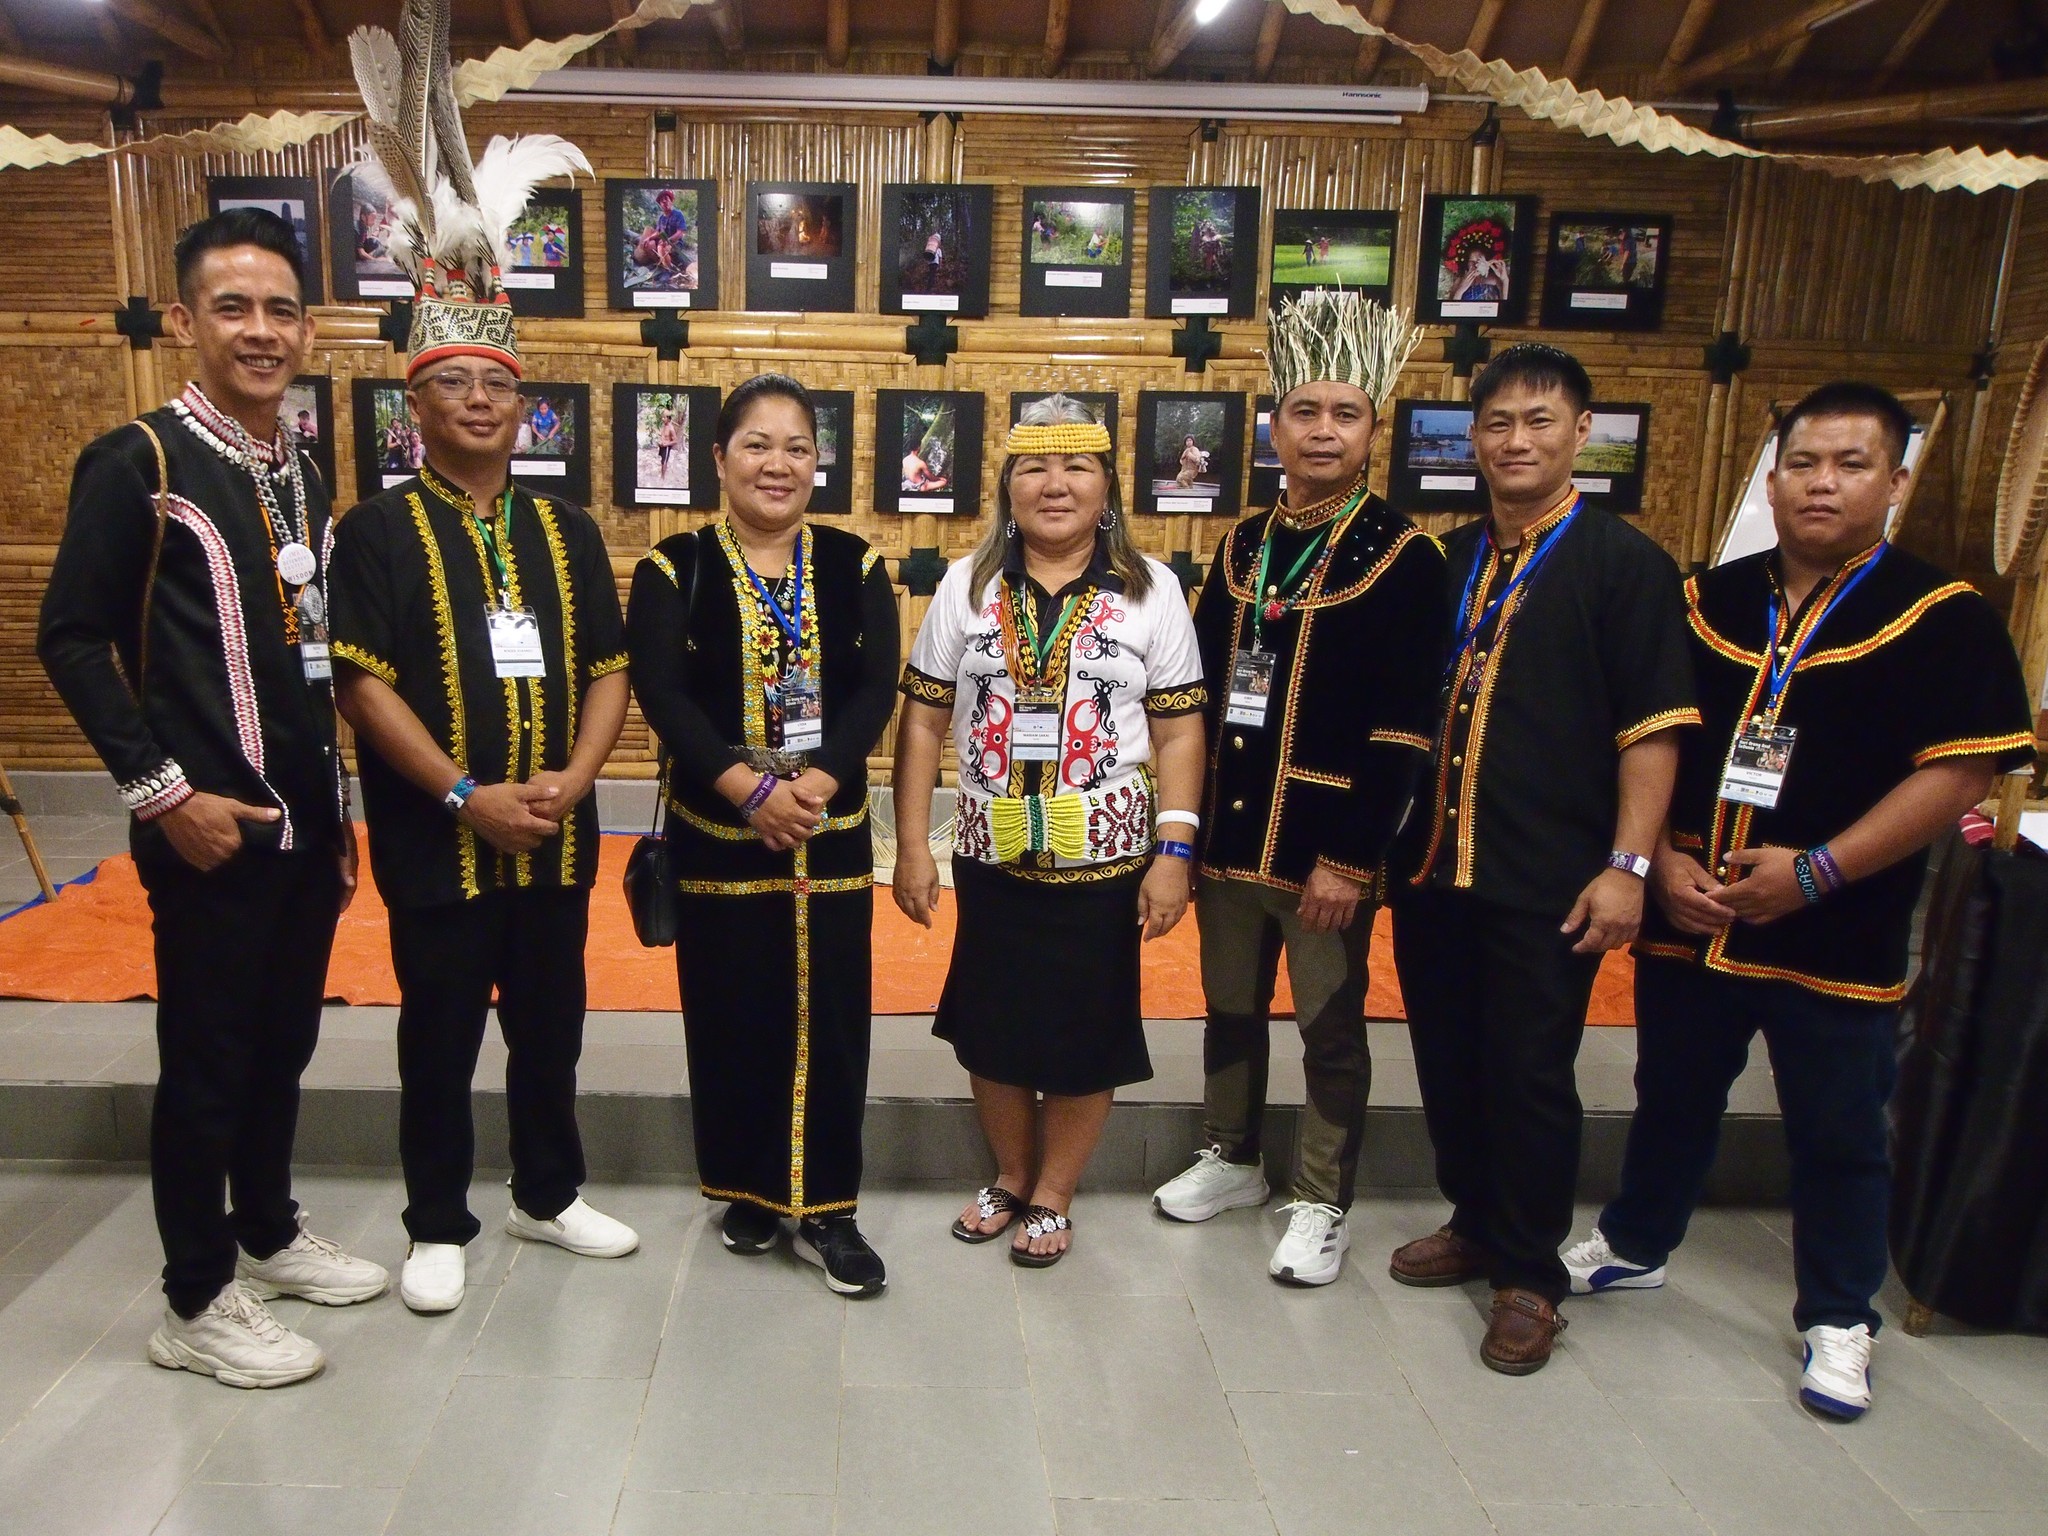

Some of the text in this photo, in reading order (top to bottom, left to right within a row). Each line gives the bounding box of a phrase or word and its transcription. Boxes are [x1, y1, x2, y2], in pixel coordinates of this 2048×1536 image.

[1342, 91, 1382, 99] Hannsonic
[286, 569, 314, 582] WISDOM
[1815, 850, 1831, 872] TADOM
